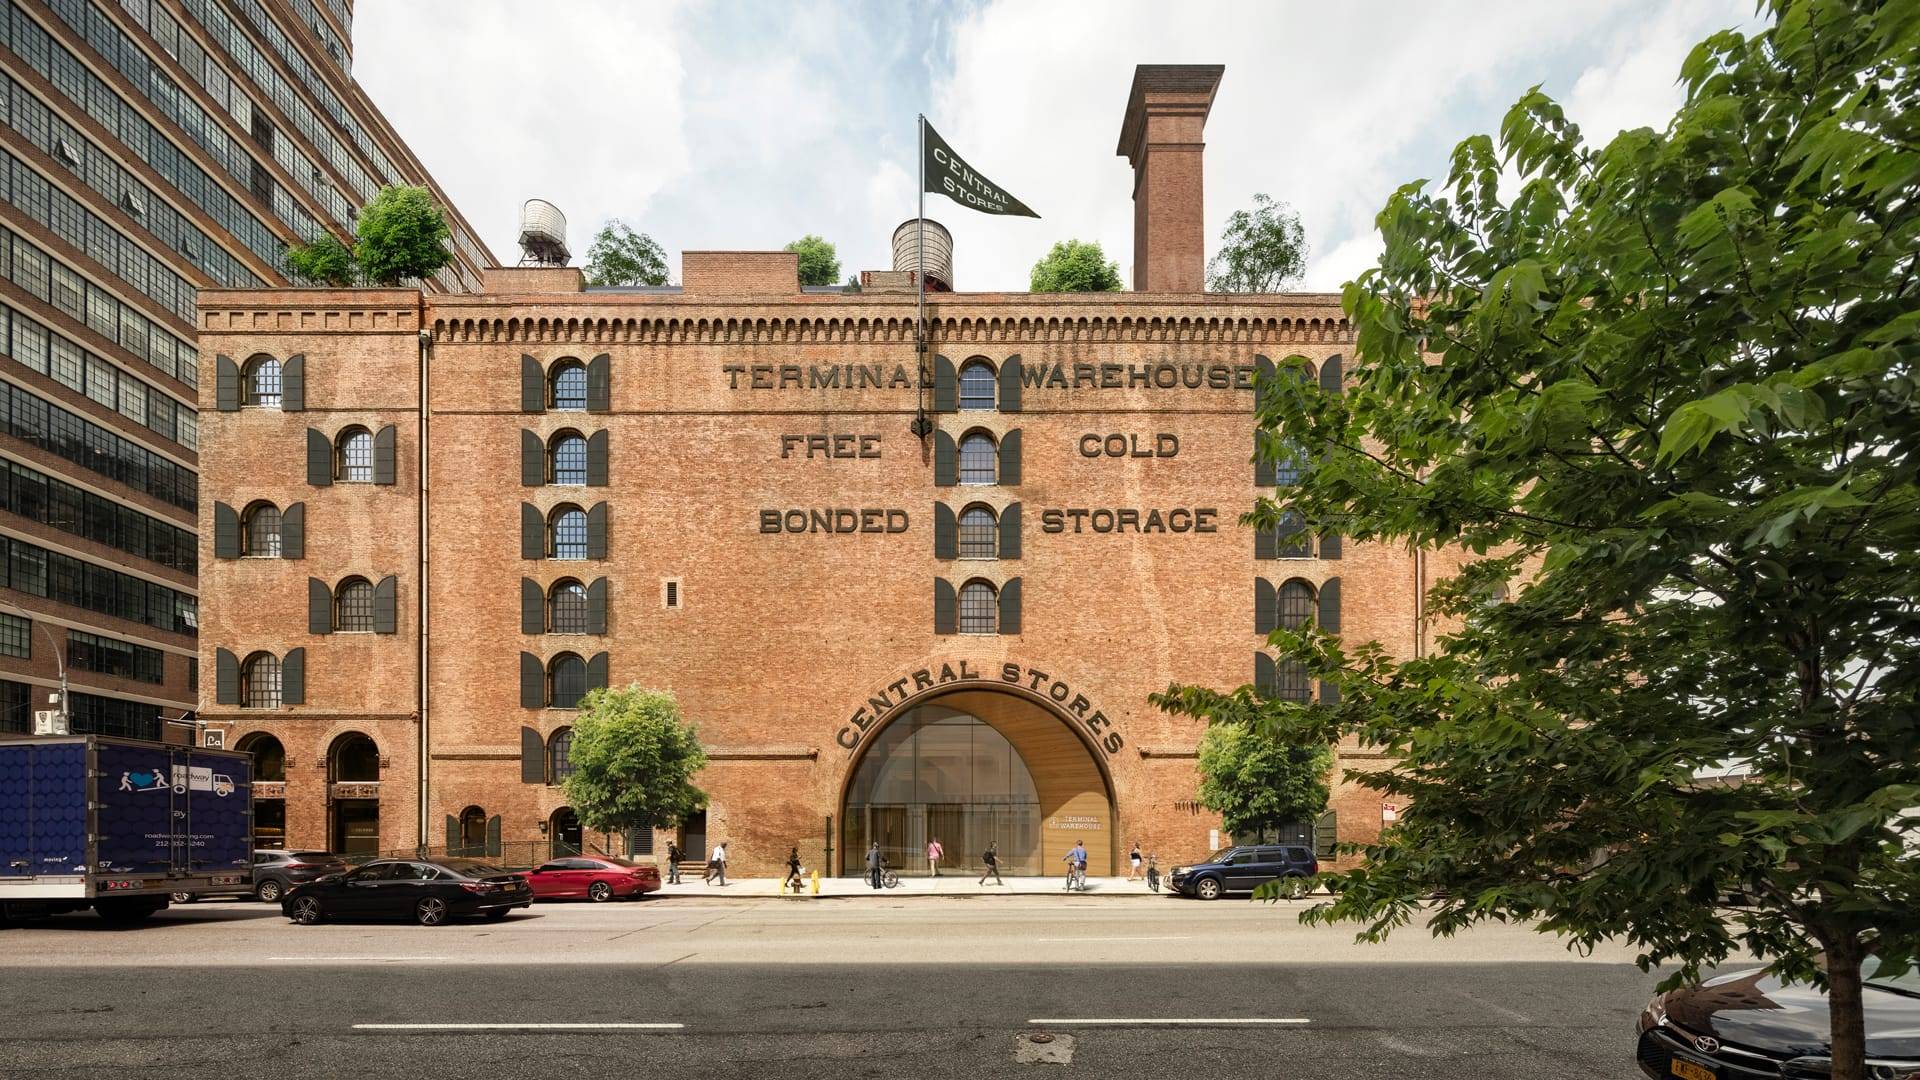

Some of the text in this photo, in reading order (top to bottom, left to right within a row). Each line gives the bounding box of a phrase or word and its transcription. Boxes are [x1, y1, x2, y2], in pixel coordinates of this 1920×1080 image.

[934, 148, 1008, 204] CENTRAL
[943, 176, 1003, 211] STORES
[723, 363, 1254, 389] TERMINAL WAREHOUSE
[781, 433, 1179, 458] FREE COLD
[759, 509, 1217, 533] BONDED STORAGE
[837, 660, 1124, 754] CENTRAL STORES
[207, 735, 221, 746] La
